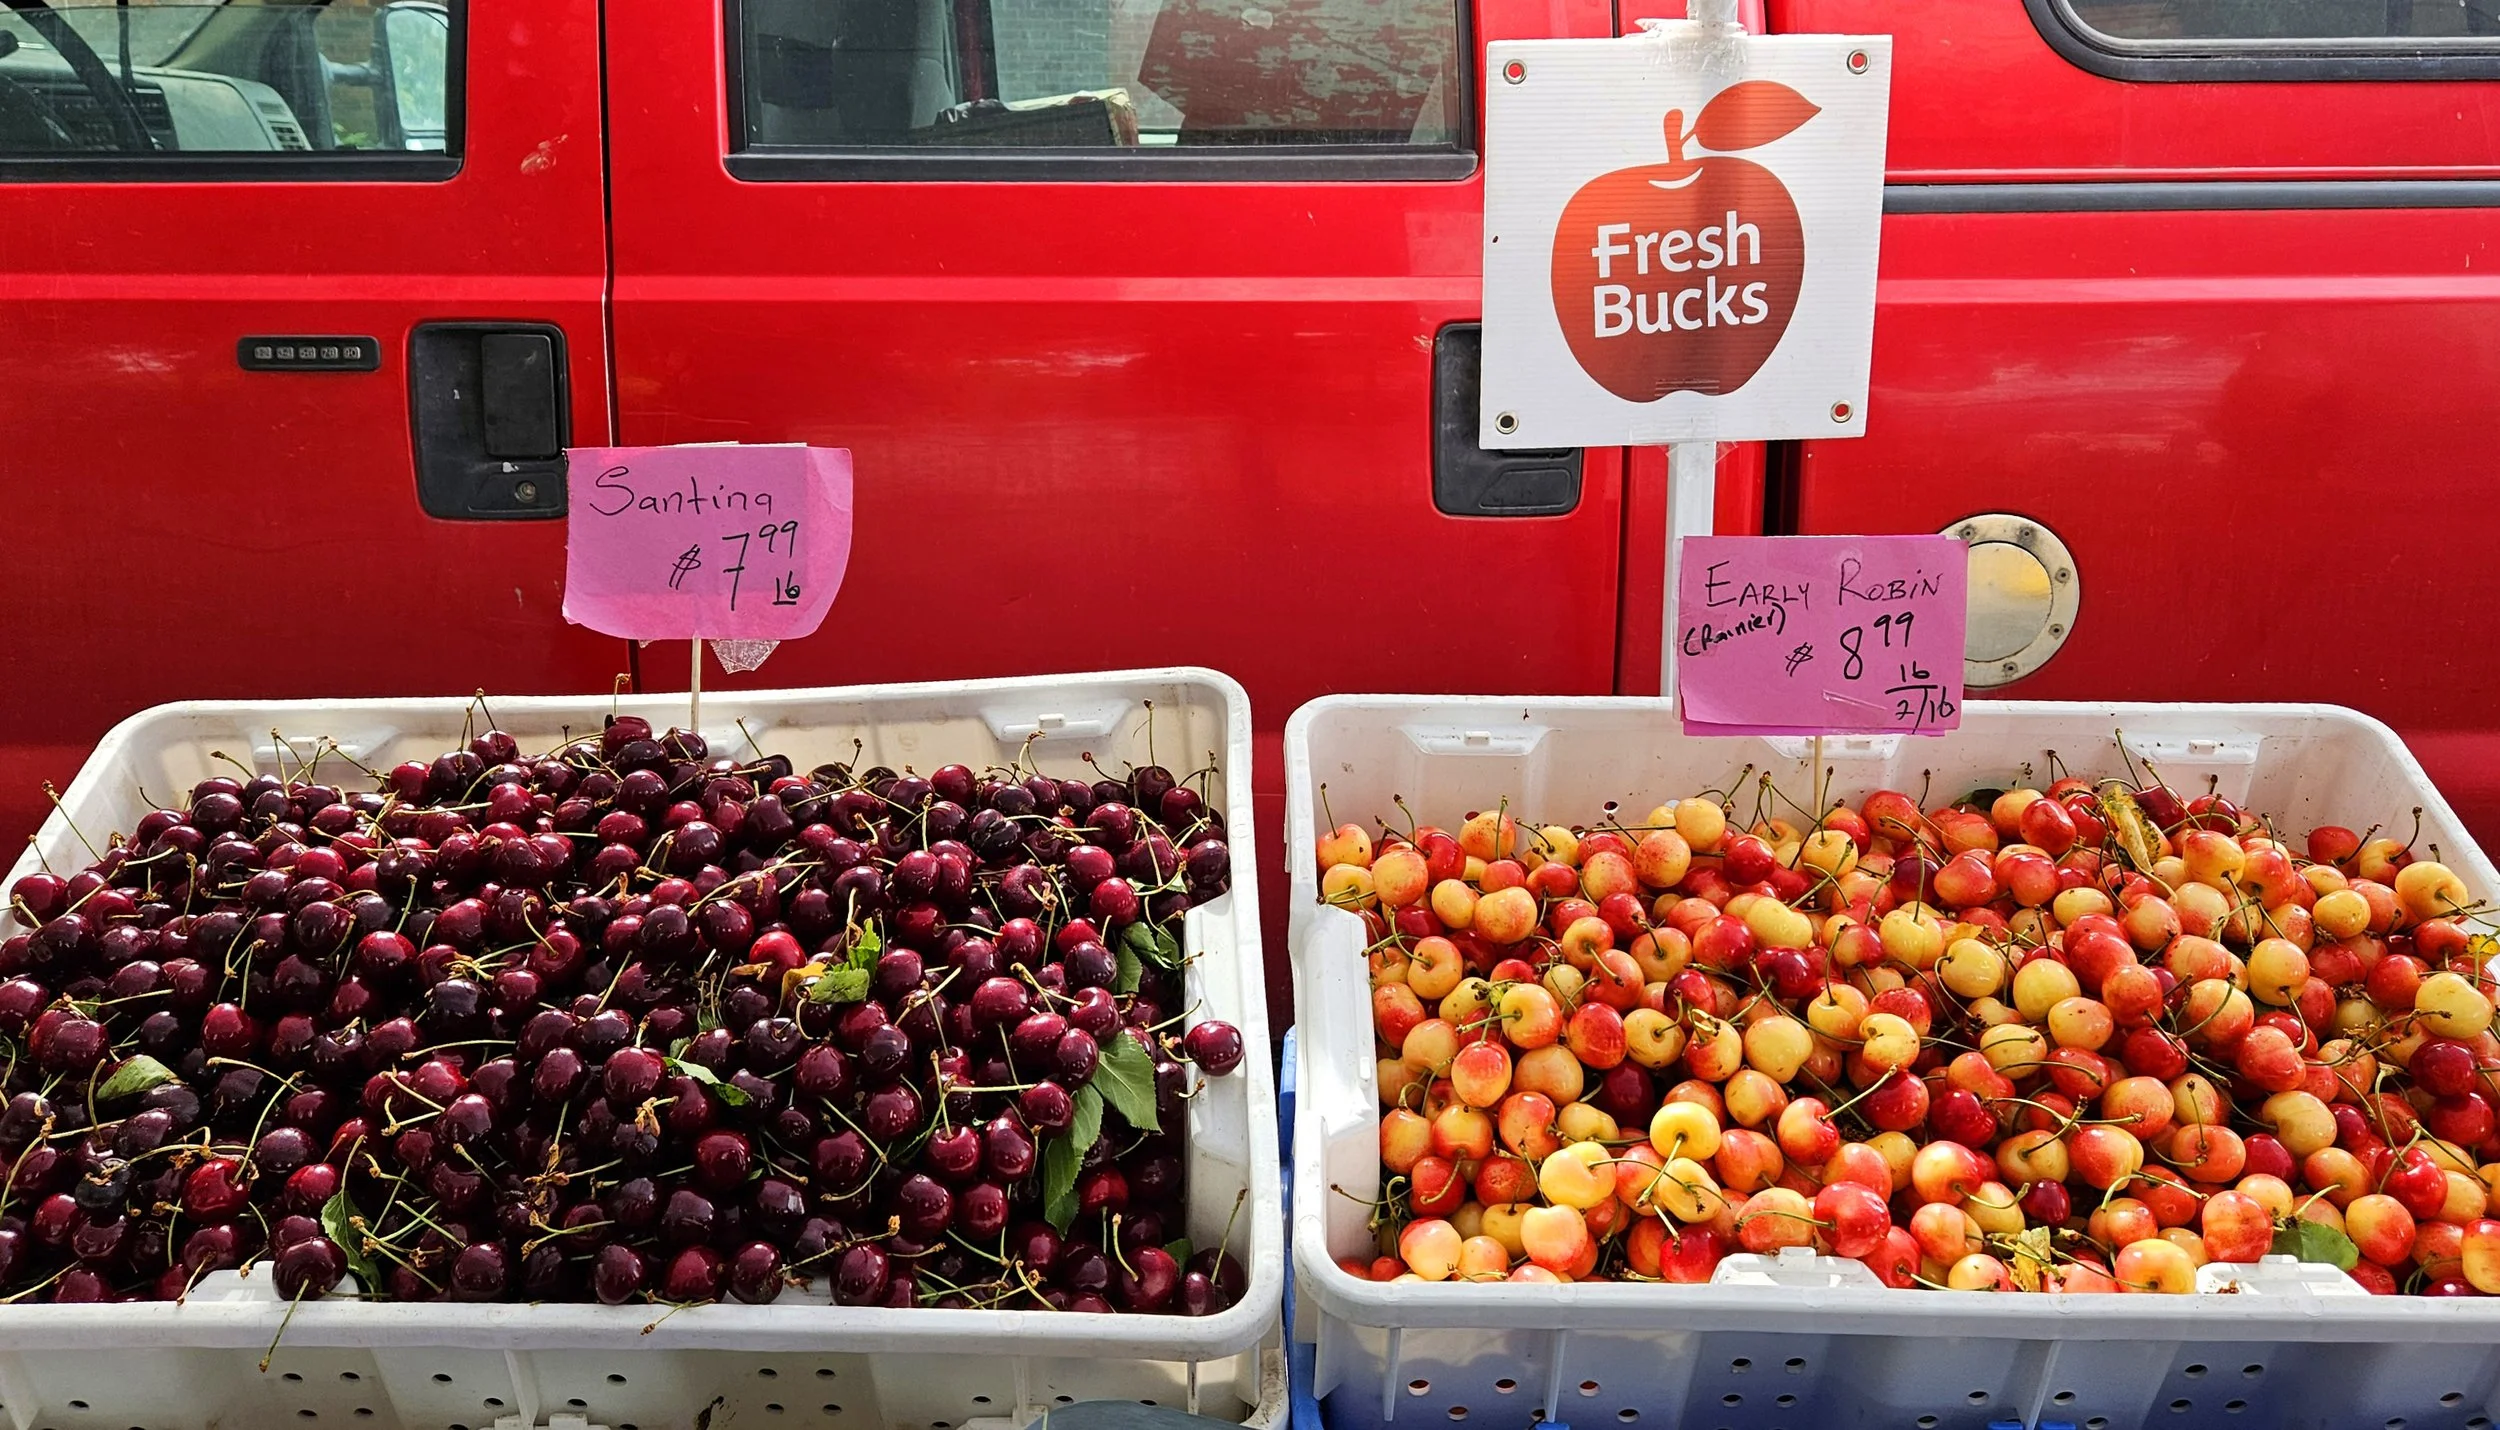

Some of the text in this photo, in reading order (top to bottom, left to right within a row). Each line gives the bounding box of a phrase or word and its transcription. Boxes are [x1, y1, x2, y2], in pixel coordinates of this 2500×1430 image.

[1591, 210, 1760, 279] Fresh
[1593, 275, 1769, 339] Bucks
[589, 466, 772, 515] Santina
[1705, 560, 1810, 609] EARLY
